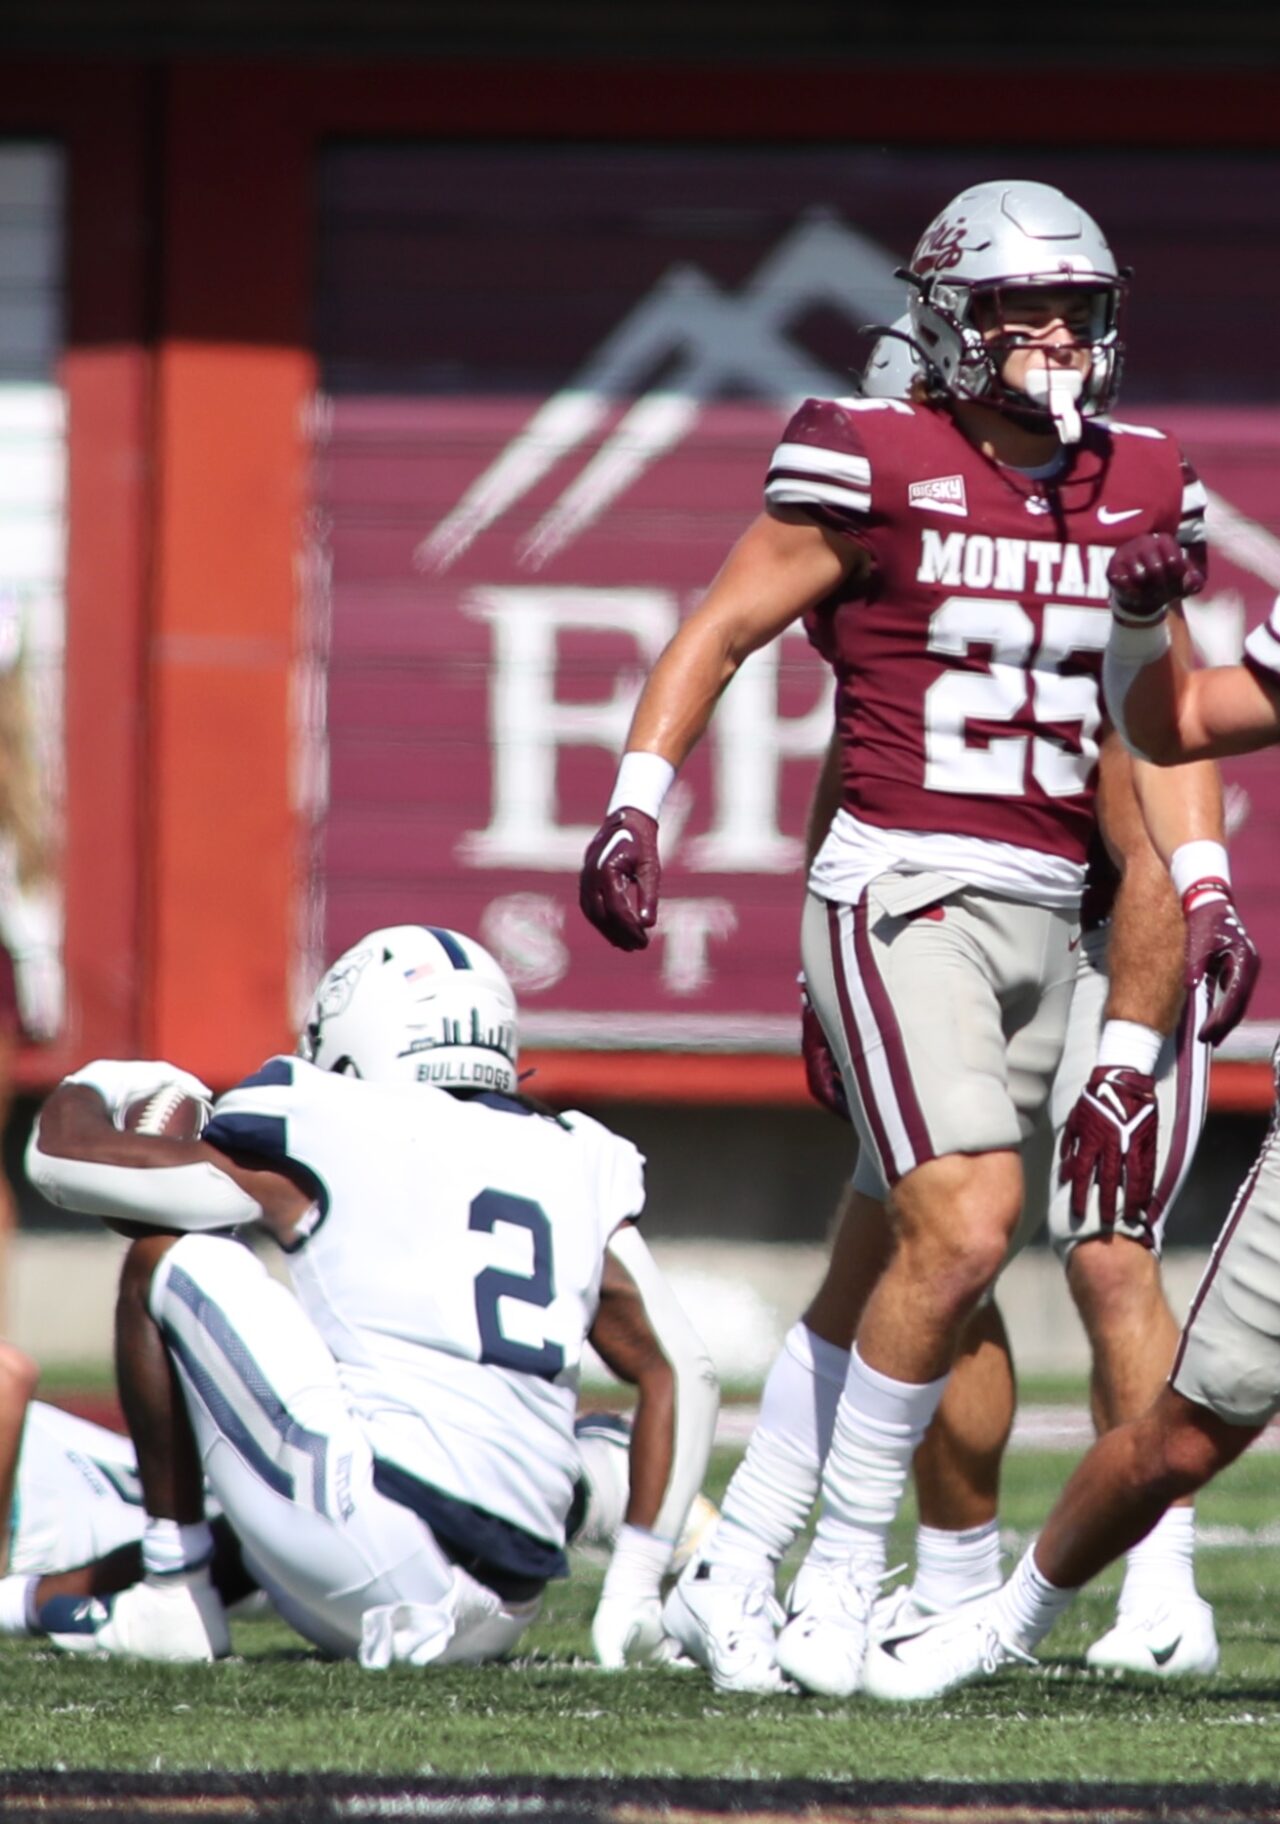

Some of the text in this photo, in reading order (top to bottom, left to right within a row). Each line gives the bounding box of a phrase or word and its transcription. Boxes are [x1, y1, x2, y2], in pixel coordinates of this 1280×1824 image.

[916, 528, 1116, 600] MONTAN
[923, 596, 1114, 797] 25
[416, 1062, 511, 1090] BULLDOGS
[468, 1187, 565, 1381] 2
